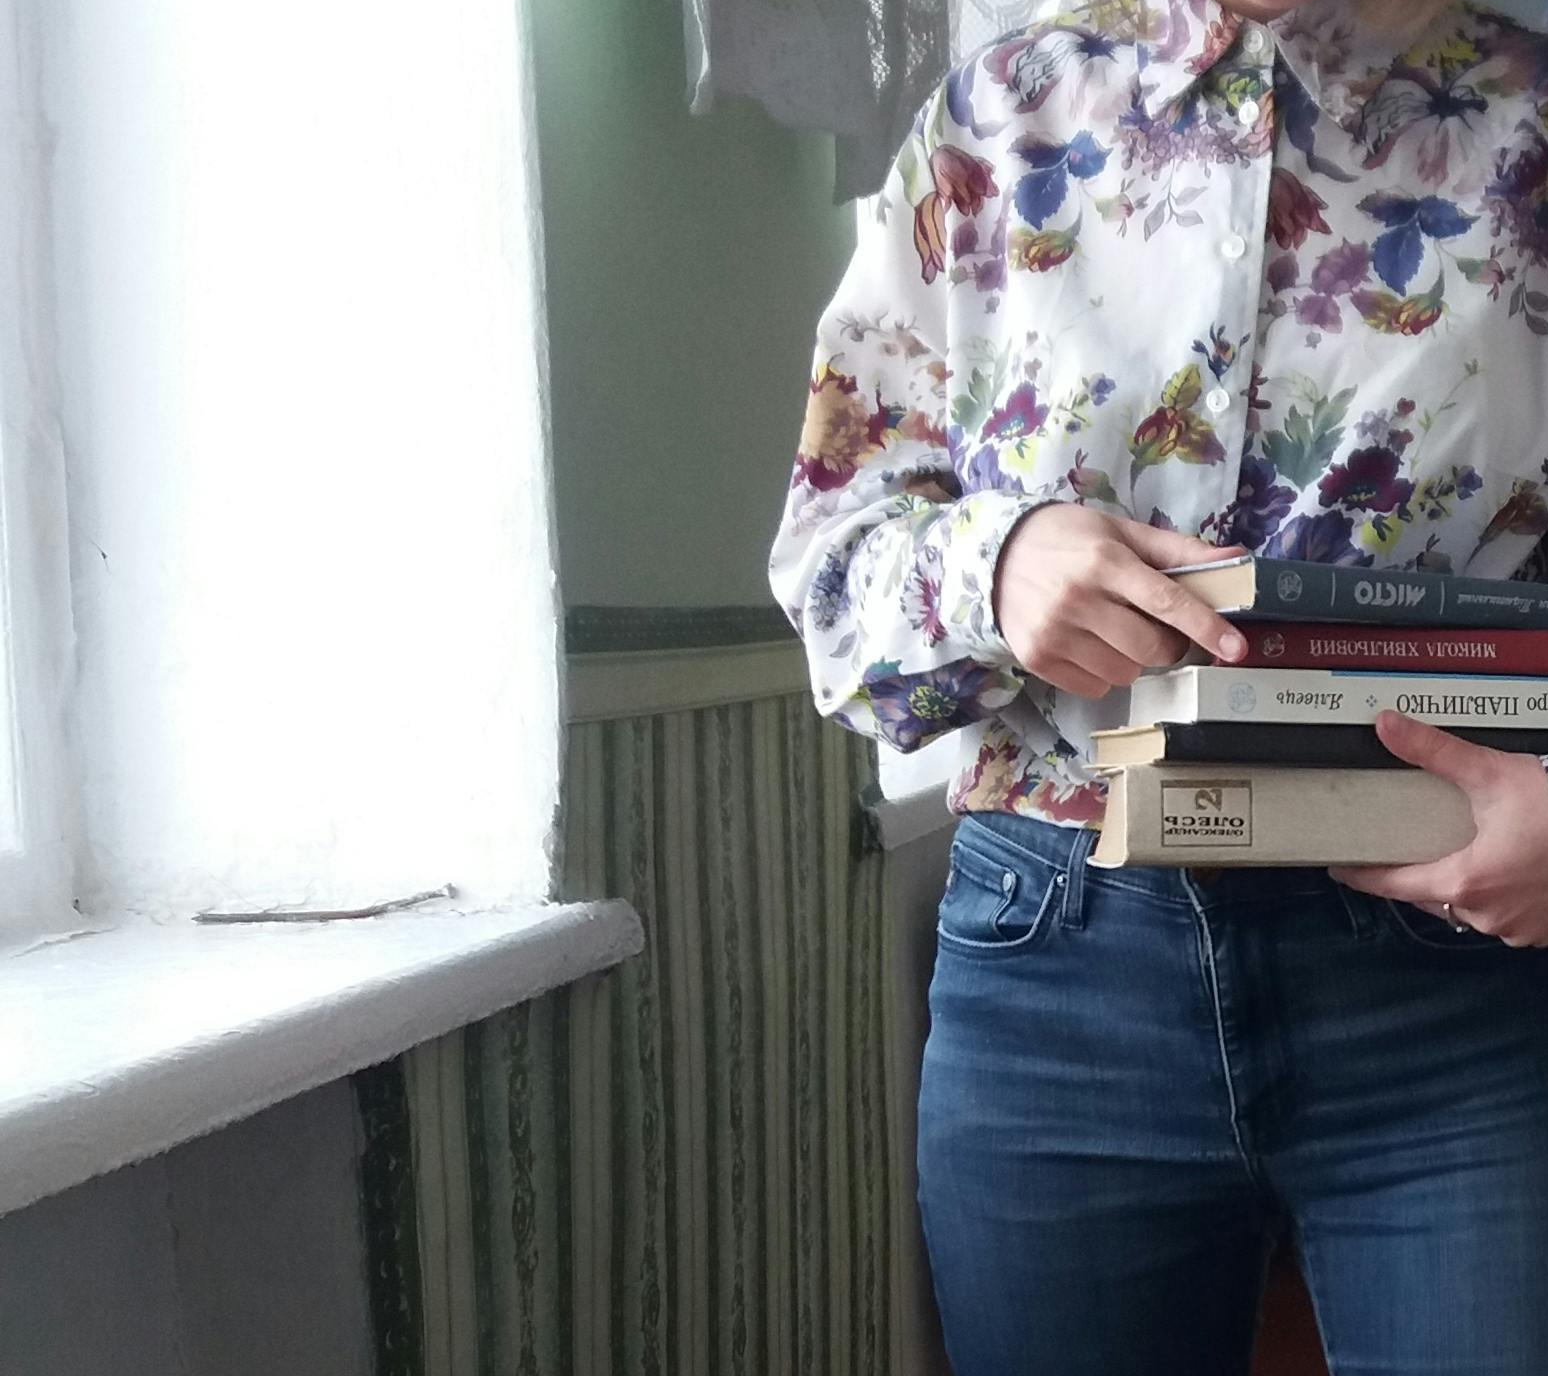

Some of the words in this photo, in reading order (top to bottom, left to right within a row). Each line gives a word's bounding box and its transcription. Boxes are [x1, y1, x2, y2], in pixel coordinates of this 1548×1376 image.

[1354, 580, 1427, 606] МІСТО
[1308, 638, 1420, 659] ХВИЛЬОВИЙ
[1427, 641, 1497, 660] МИКОЛА
[1276, 690, 1344, 711] Ялівець
[1396, 692, 1520, 717] ПАВЛИЧКО
[1194, 787, 1222, 812] 2
[1164, 815, 1245, 829] ОЛЕСЬ
[1165, 827, 1245, 837] ОЛЕКСАНДР
